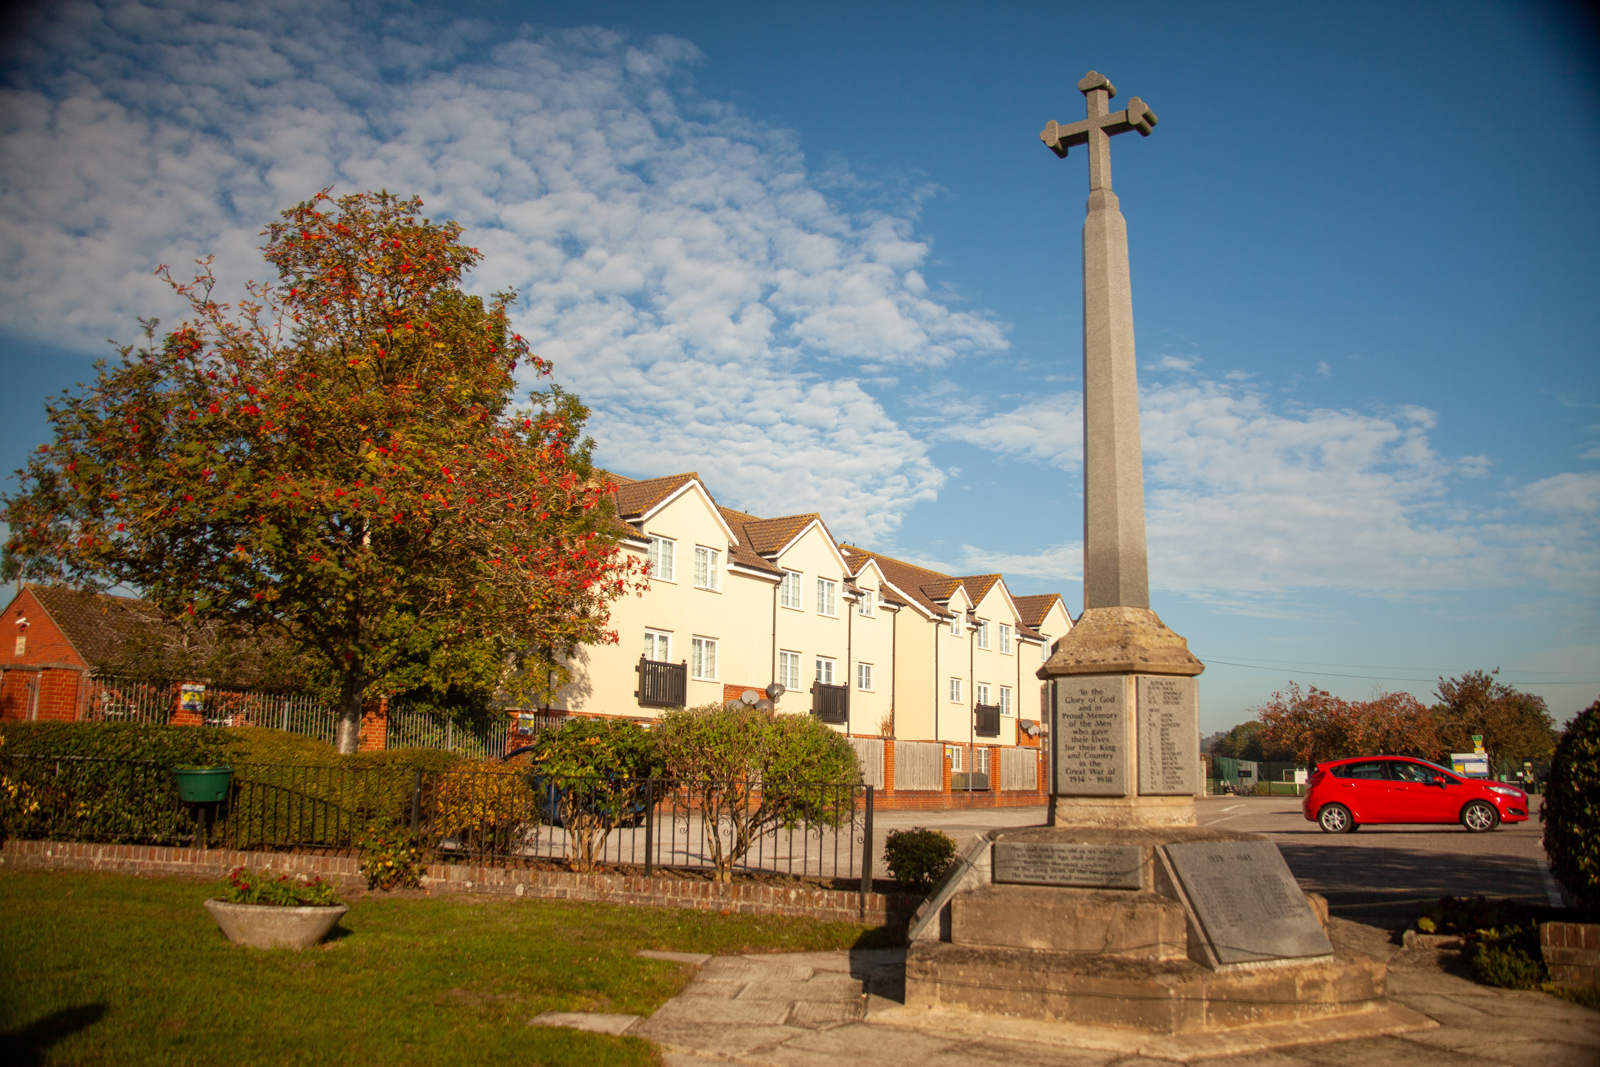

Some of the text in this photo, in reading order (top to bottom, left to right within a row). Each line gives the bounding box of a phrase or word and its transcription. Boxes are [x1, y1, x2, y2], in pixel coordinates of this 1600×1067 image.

[1065, 696, 1085, 705] Glory
[1100, 744, 1116, 752] King
[1084, 752, 1113, 760] Country
